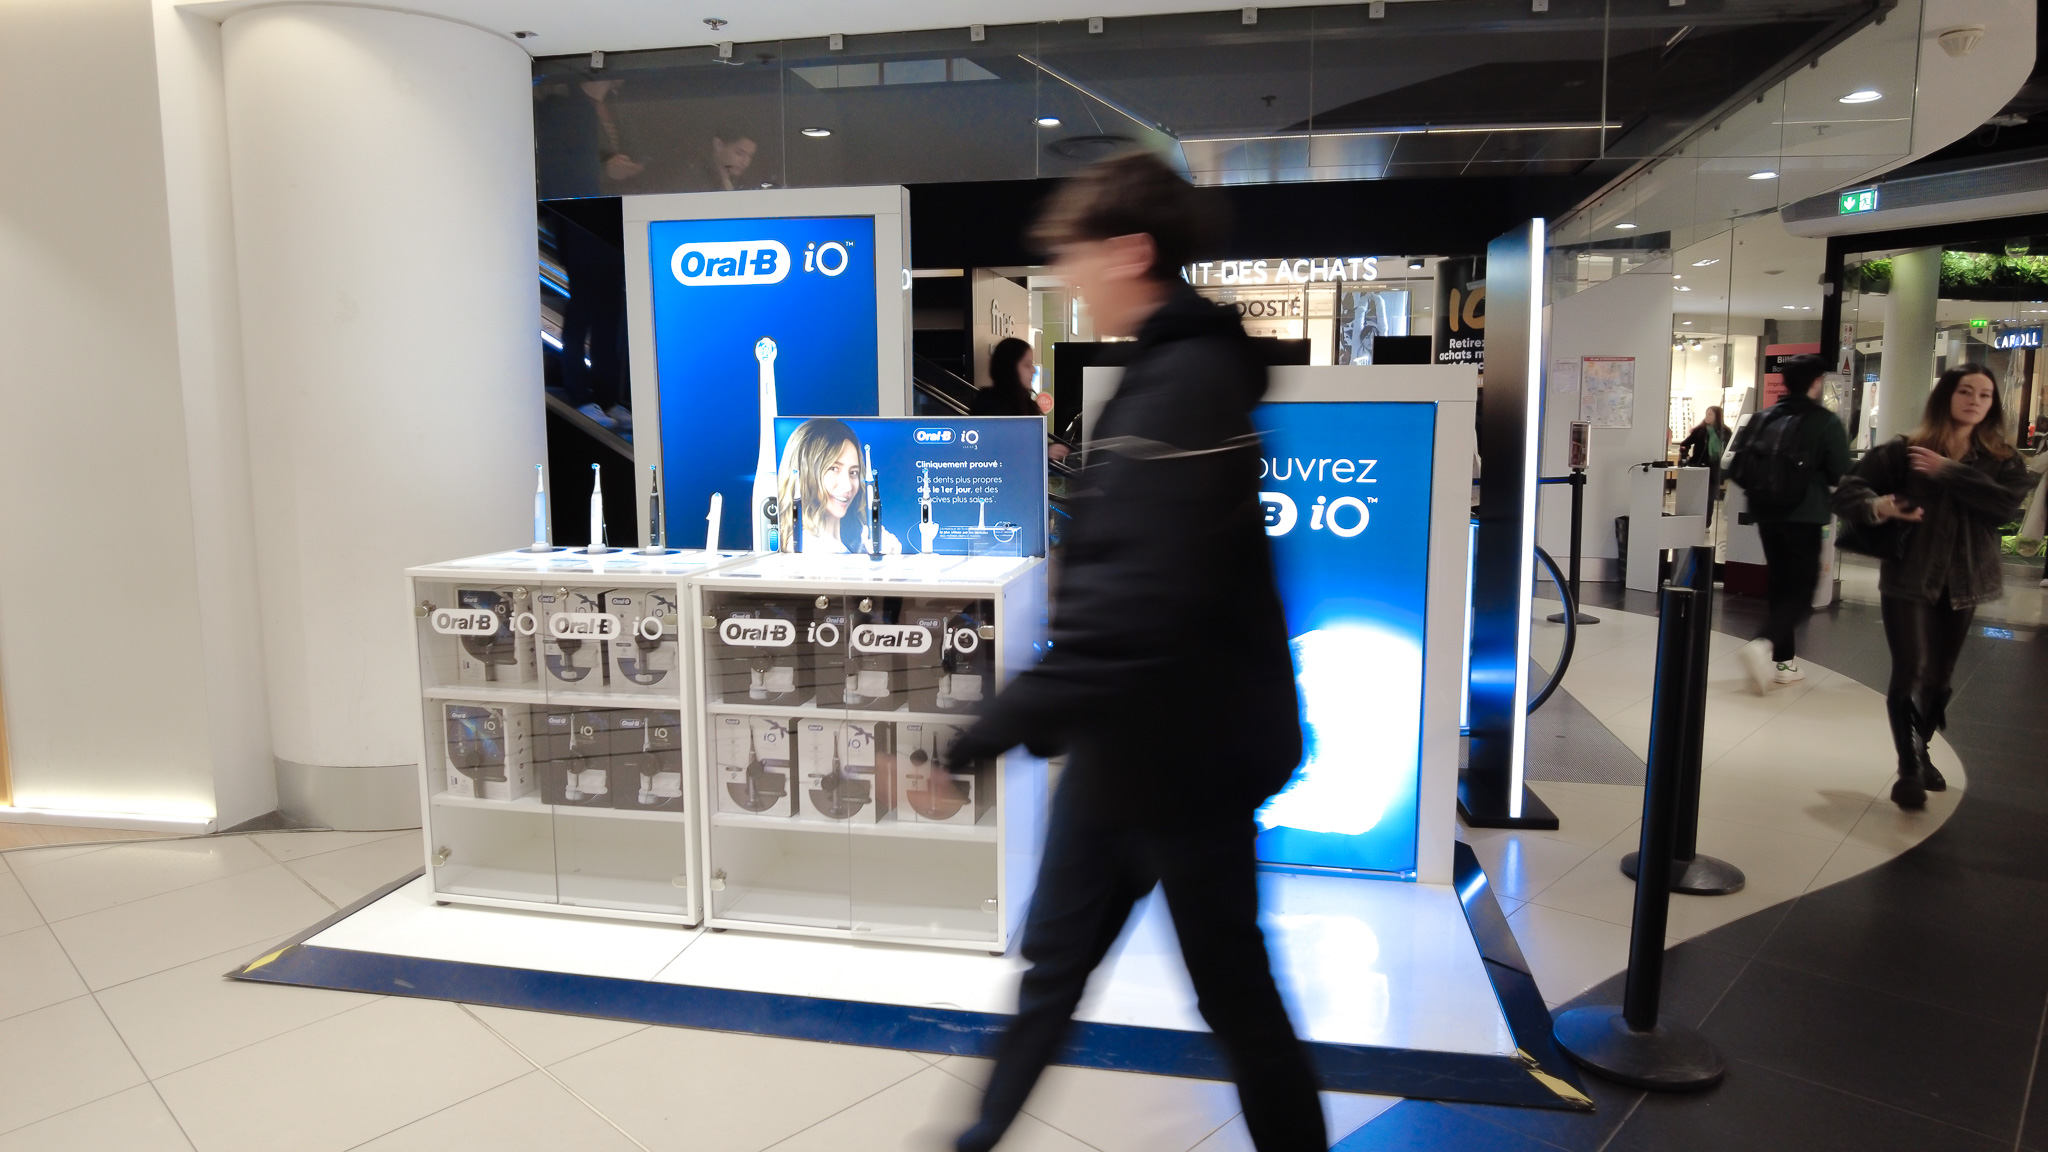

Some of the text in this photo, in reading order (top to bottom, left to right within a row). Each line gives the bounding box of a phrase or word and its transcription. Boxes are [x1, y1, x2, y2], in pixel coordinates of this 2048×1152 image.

[680, 248, 778, 278] Oral-B
[1221, 260, 1268, 284] DES
[1274, 256, 1379, 284] ACHATS
[1439, 349, 1472, 361] achats
[916, 430, 952, 441] Oral-B
[915, 460, 968, 470] Cliniquement
[969, 459, 998, 470] prouvé
[932, 485, 940, 493] le
[974, 485, 983, 493] et
[984, 485, 999, 493] des
[933, 475, 954, 484] dents
[955, 475, 971, 486] plus
[972, 475, 1003, 486] propres
[952, 495, 968, 504] plus
[436, 611, 538, 636] Oral-B iO
[554, 615, 663, 641] Oral-B iO
[725, 621, 840, 647] Oral-B iO
[857, 627, 979, 654] Oral-B iO
